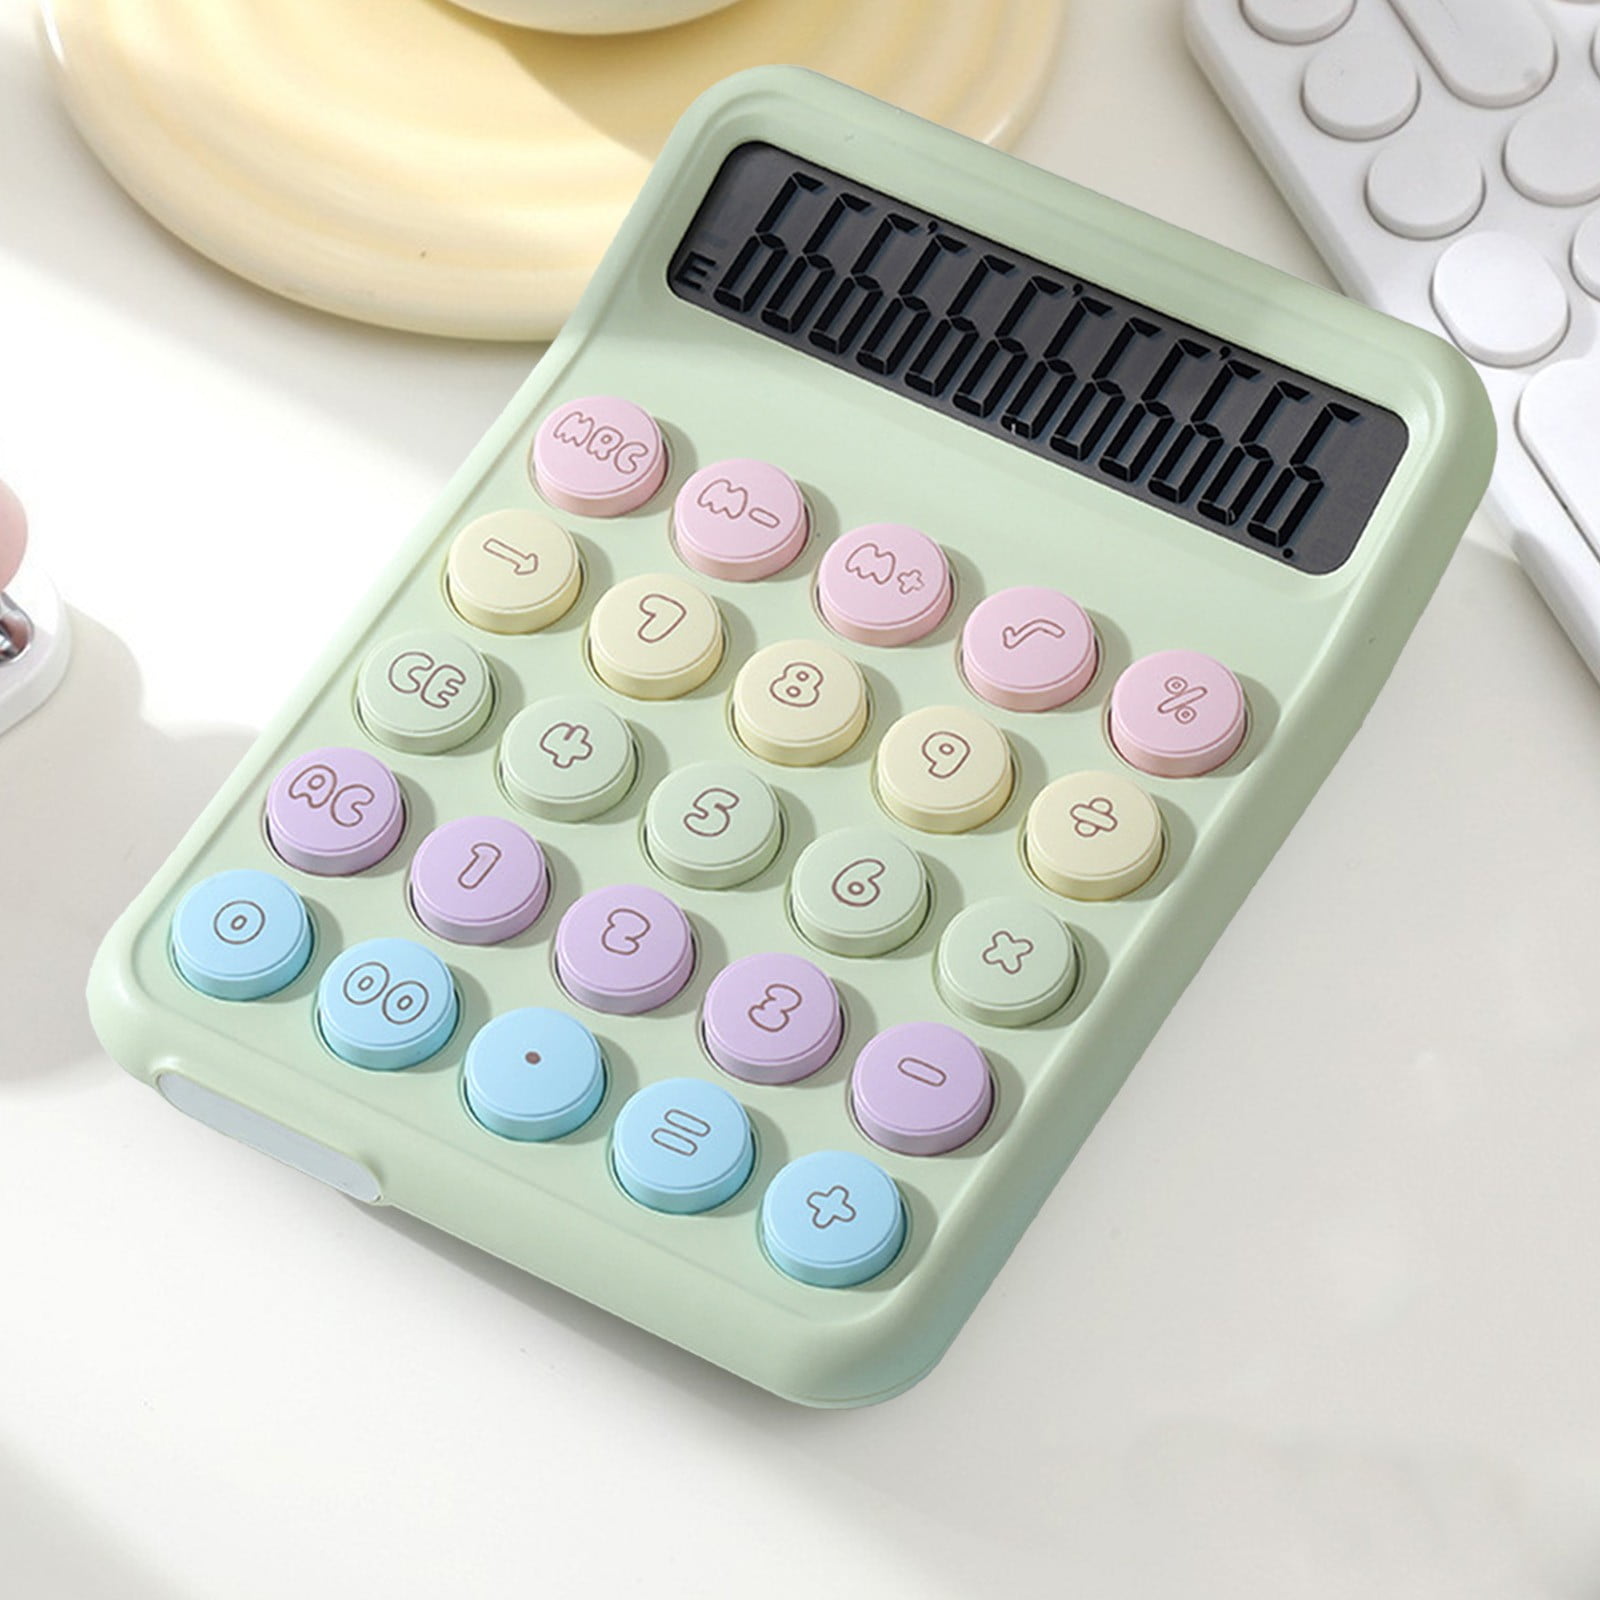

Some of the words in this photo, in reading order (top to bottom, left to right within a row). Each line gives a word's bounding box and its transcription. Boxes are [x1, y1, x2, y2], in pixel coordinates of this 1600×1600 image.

[674, 251, 717, 291] E
[553, 411, 649, 474] MRC
[697, 479, 780, 528] M-
[845, 543, 924, 595] M+
[637, 594, 687, 643] 7
[388, 652, 466, 709] CE
[769, 662, 824, 708] 8
[539, 722, 593, 769] 4
[921, 731, 971, 779] 9
[288, 764, 375, 827] AC
[683, 788, 740, 837] 5
[457, 842, 502, 890] 1
[831, 858, 885, 907] 6
[213, 900, 266, 945] 0
[601, 908, 651, 955] 2
[343, 961, 429, 1025] 00
[747, 983, 802, 1033] 3
